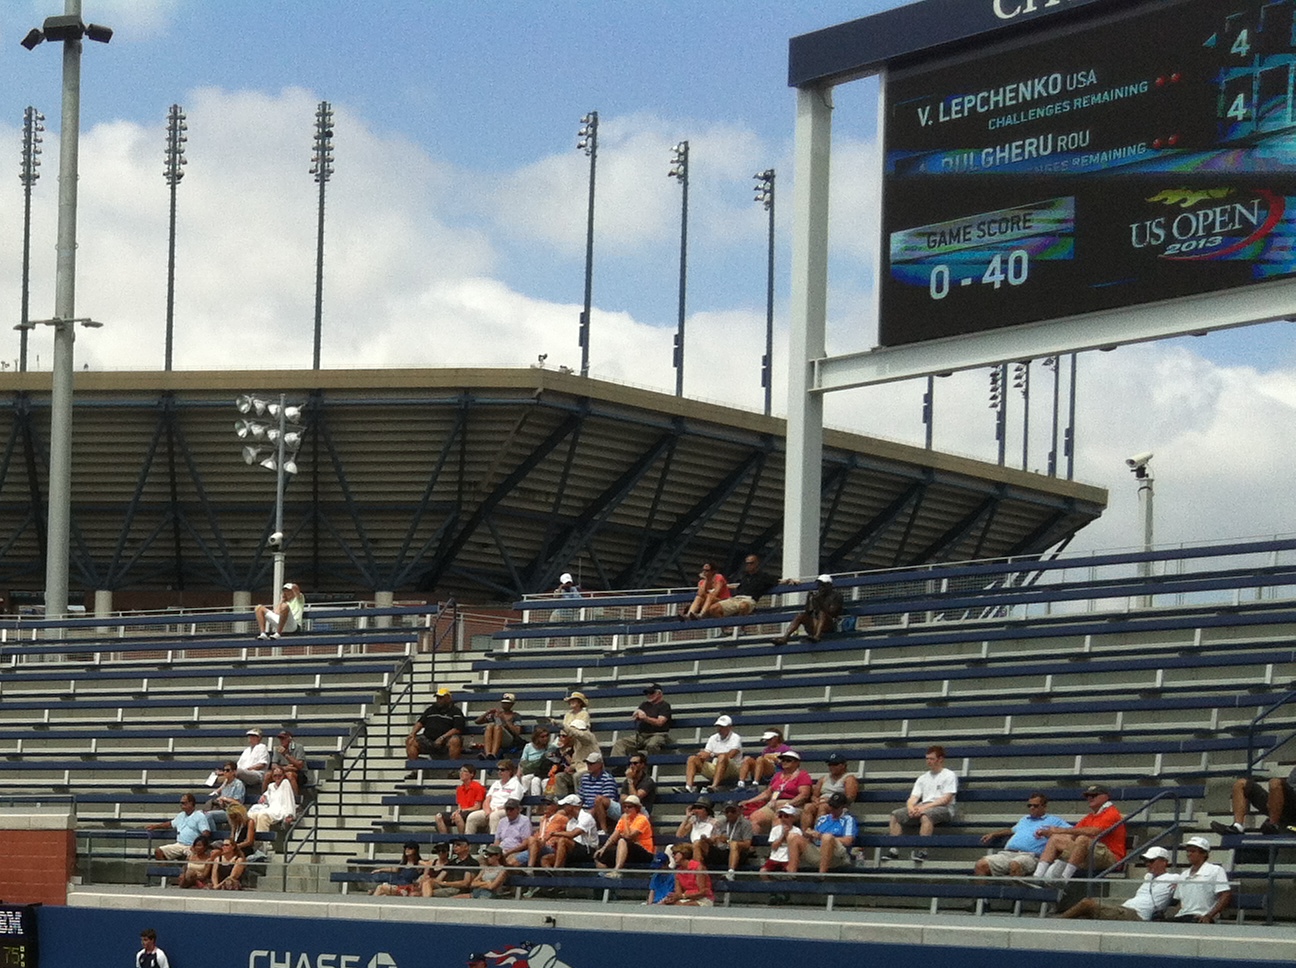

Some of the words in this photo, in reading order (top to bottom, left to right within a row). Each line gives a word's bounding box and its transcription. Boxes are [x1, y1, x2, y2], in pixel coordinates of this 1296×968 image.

[1229, 29, 1251, 56] 4
[917, 105, 934, 127] V.
[938, 73, 1062, 122] LEPCHENKO
[1066, 69, 1098, 91] USA
[988, 100, 1071, 130] CHALLENGES
[1073, 81, 1149, 110] REMAINING
[1226, 93, 1248, 121] 4
[1057, 130, 1091, 153] ROU
[926, 223, 972, 249] GAME
[976, 212, 1034, 240] SCORE
[1129, 219, 1166, 248] US
[1171, 199, 1263, 240] OPEN
[1163, 235, 1223, 255] 2013
[981, 249, 1030, 290] 40
